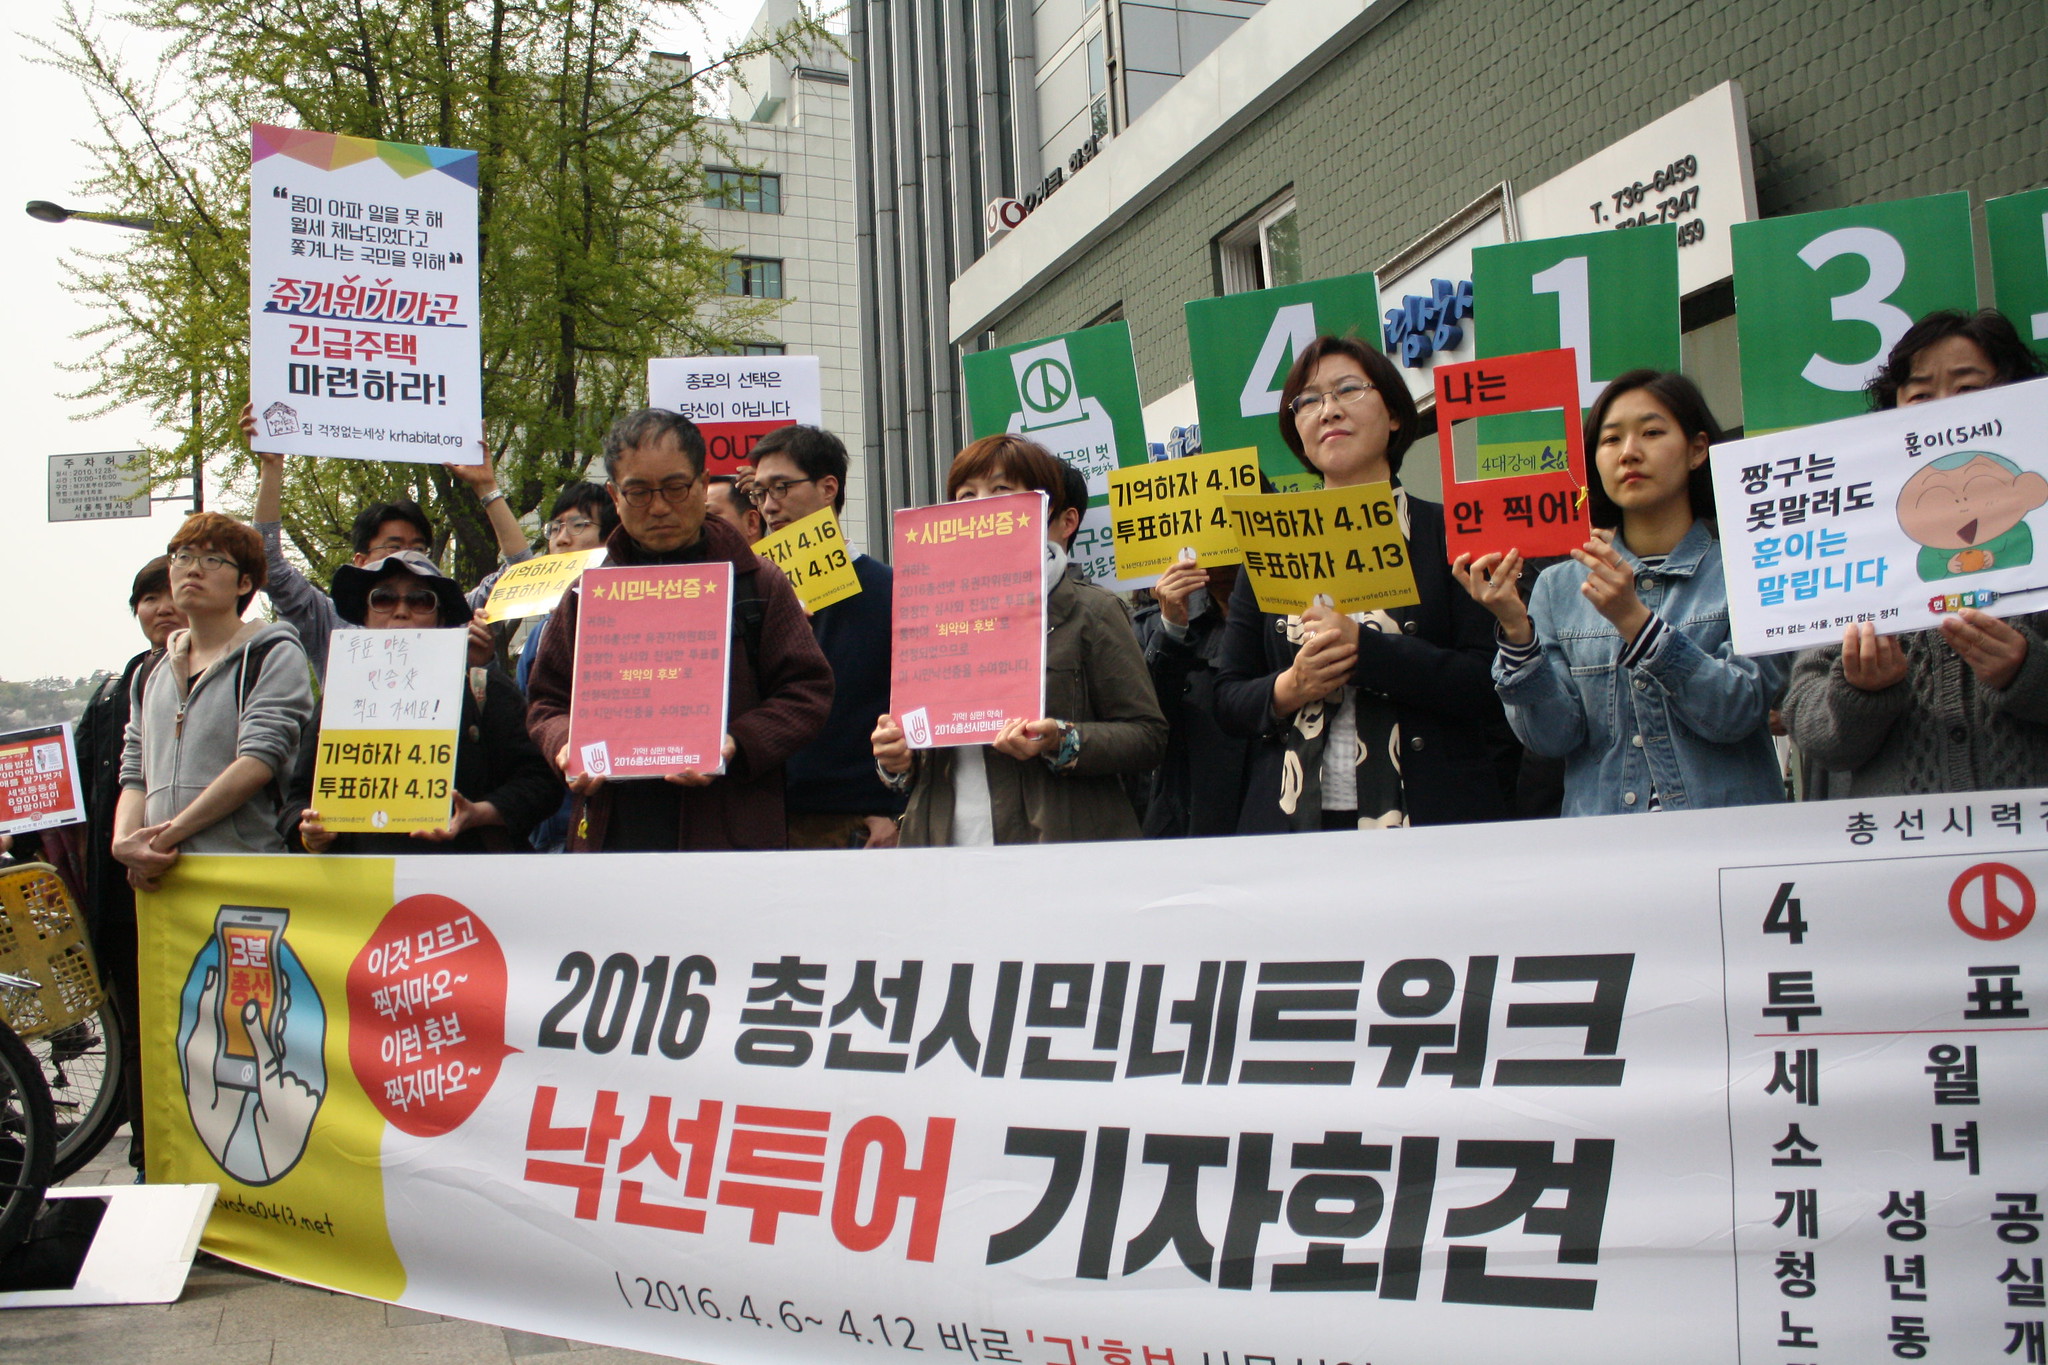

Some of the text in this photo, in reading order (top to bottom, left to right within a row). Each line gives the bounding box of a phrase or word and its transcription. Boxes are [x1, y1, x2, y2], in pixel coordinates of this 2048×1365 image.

[1612, 154, 1697, 213] 736-6459
[329, 199, 363, 220] 아파
[369, 205, 399, 224] 일을
[291, 216, 429, 248] 월세 체납되었다고
[291, 239, 355, 262] 쫓겨나는
[361, 246, 406, 267] 국민을
[272, 277, 458, 324] 주거위기가구
[1797, 227, 1914, 391] 3
[289, 323, 417, 366] 긴급주택
[1532, 256, 1612, 411] 1
[288, 363, 447, 406] 마련하라!
[685, 371, 782, 390] 종로의 선택은
[1444, 371, 1507, 405] 나는
[680, 400, 790, 419] 당신이 아닙니다
[302, 423, 313, 435] 집
[389, 430, 463, 448] krhabitat.org
[1904, 418, 2003, 458] 훈이(5세)
[1057, 443, 1110, 468] 구의 벗
[1482, 445, 1569, 473] 4대강에 심
[1111, 471, 1198, 508] 기억하자
[1206, 464, 1256, 491] 4.16
[1740, 453, 1836, 495] 짱구는
[1231, 500, 1393, 538] 기억하자 4.16
[1454, 491, 1580, 535] 안 찍어!
[1746, 481, 1875, 533] 못말려도
[797, 520, 836, 550] 4.16
[920, 511, 1014, 545] 시민낙선증
[1068, 526, 1113, 558] 구의
[1116, 507, 1233, 545] 투표하자 4.
[808, 549, 847, 578] 4.13
[1245, 543, 1404, 579] 투표하자 4.13
[1751, 528, 1848, 569] 훈이는
[503, 561, 562, 581] 기억하자
[1757, 556, 1888, 607] 말립니다
[491, 581, 550, 601] 투표하자
[607, 578, 701, 601] 시민낙선증
[1765, 625, 1784, 638] 먼지
[1787, 622, 1806, 635] 없는
[1834, 615, 1853, 627] 먼지
[1857, 612, 1876, 624] 없는
[1879, 607, 1899, 619] 정치
[390, 699, 440, 721] 가세요!
[935, 718, 1022, 736] 2016총선시민네트
[952, 709, 1003, 722] 기억! 심판! 약속!
[323, 743, 450, 765] 기억하자 4.16
[614, 754, 700, 767] 2016총선시민네트워크
[318, 777, 447, 799] 투표하자 4.13
[1763, 882, 1808, 944] 4
[230, 936, 267, 968] 3분
[368, 916, 479, 977] 이것 모르고
[231, 970, 272, 1008] 총선
[372, 969, 468, 1022] 찍지마오~
[537, 950, 1635, 1088] 2016 총선시민네트워크
[381, 1012, 466, 1067] 이런 후보
[384, 1061, 481, 1113] 찍지마오~
[523, 1085, 1615, 1310] 낙선투어 기자회견
[937, 1321, 1022, 1364] 바로
